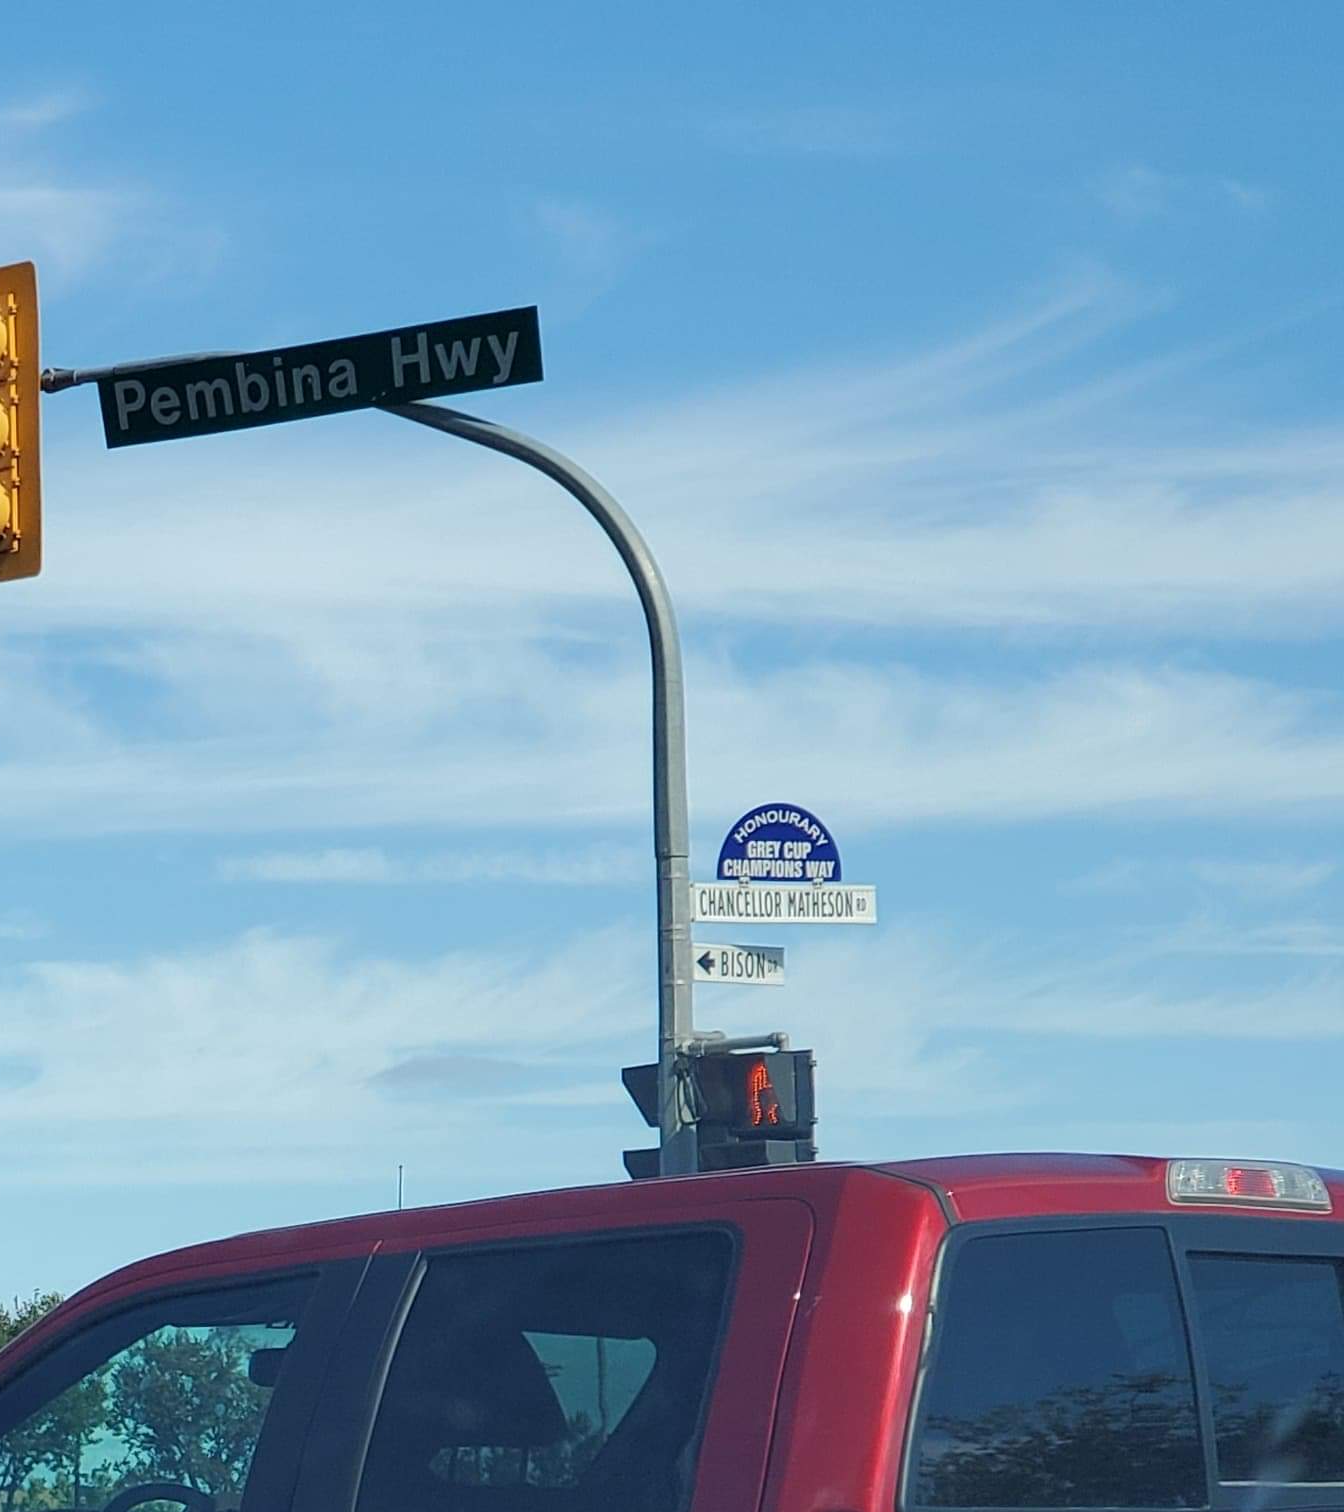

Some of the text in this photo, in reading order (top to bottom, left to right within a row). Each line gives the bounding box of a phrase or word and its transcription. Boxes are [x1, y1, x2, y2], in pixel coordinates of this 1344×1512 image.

[115, 331, 519, 431] Pembina Hwy
[734, 810, 828, 846] HONOURARY
[747, 841, 812, 859] GREY CUP
[723, 859, 835, 878] CHAMPIONS WAY
[699, 889, 782, 918] CHANCELLOR
[787, 891, 854, 918] MATHESON
[721, 951, 767, 979] BISON
